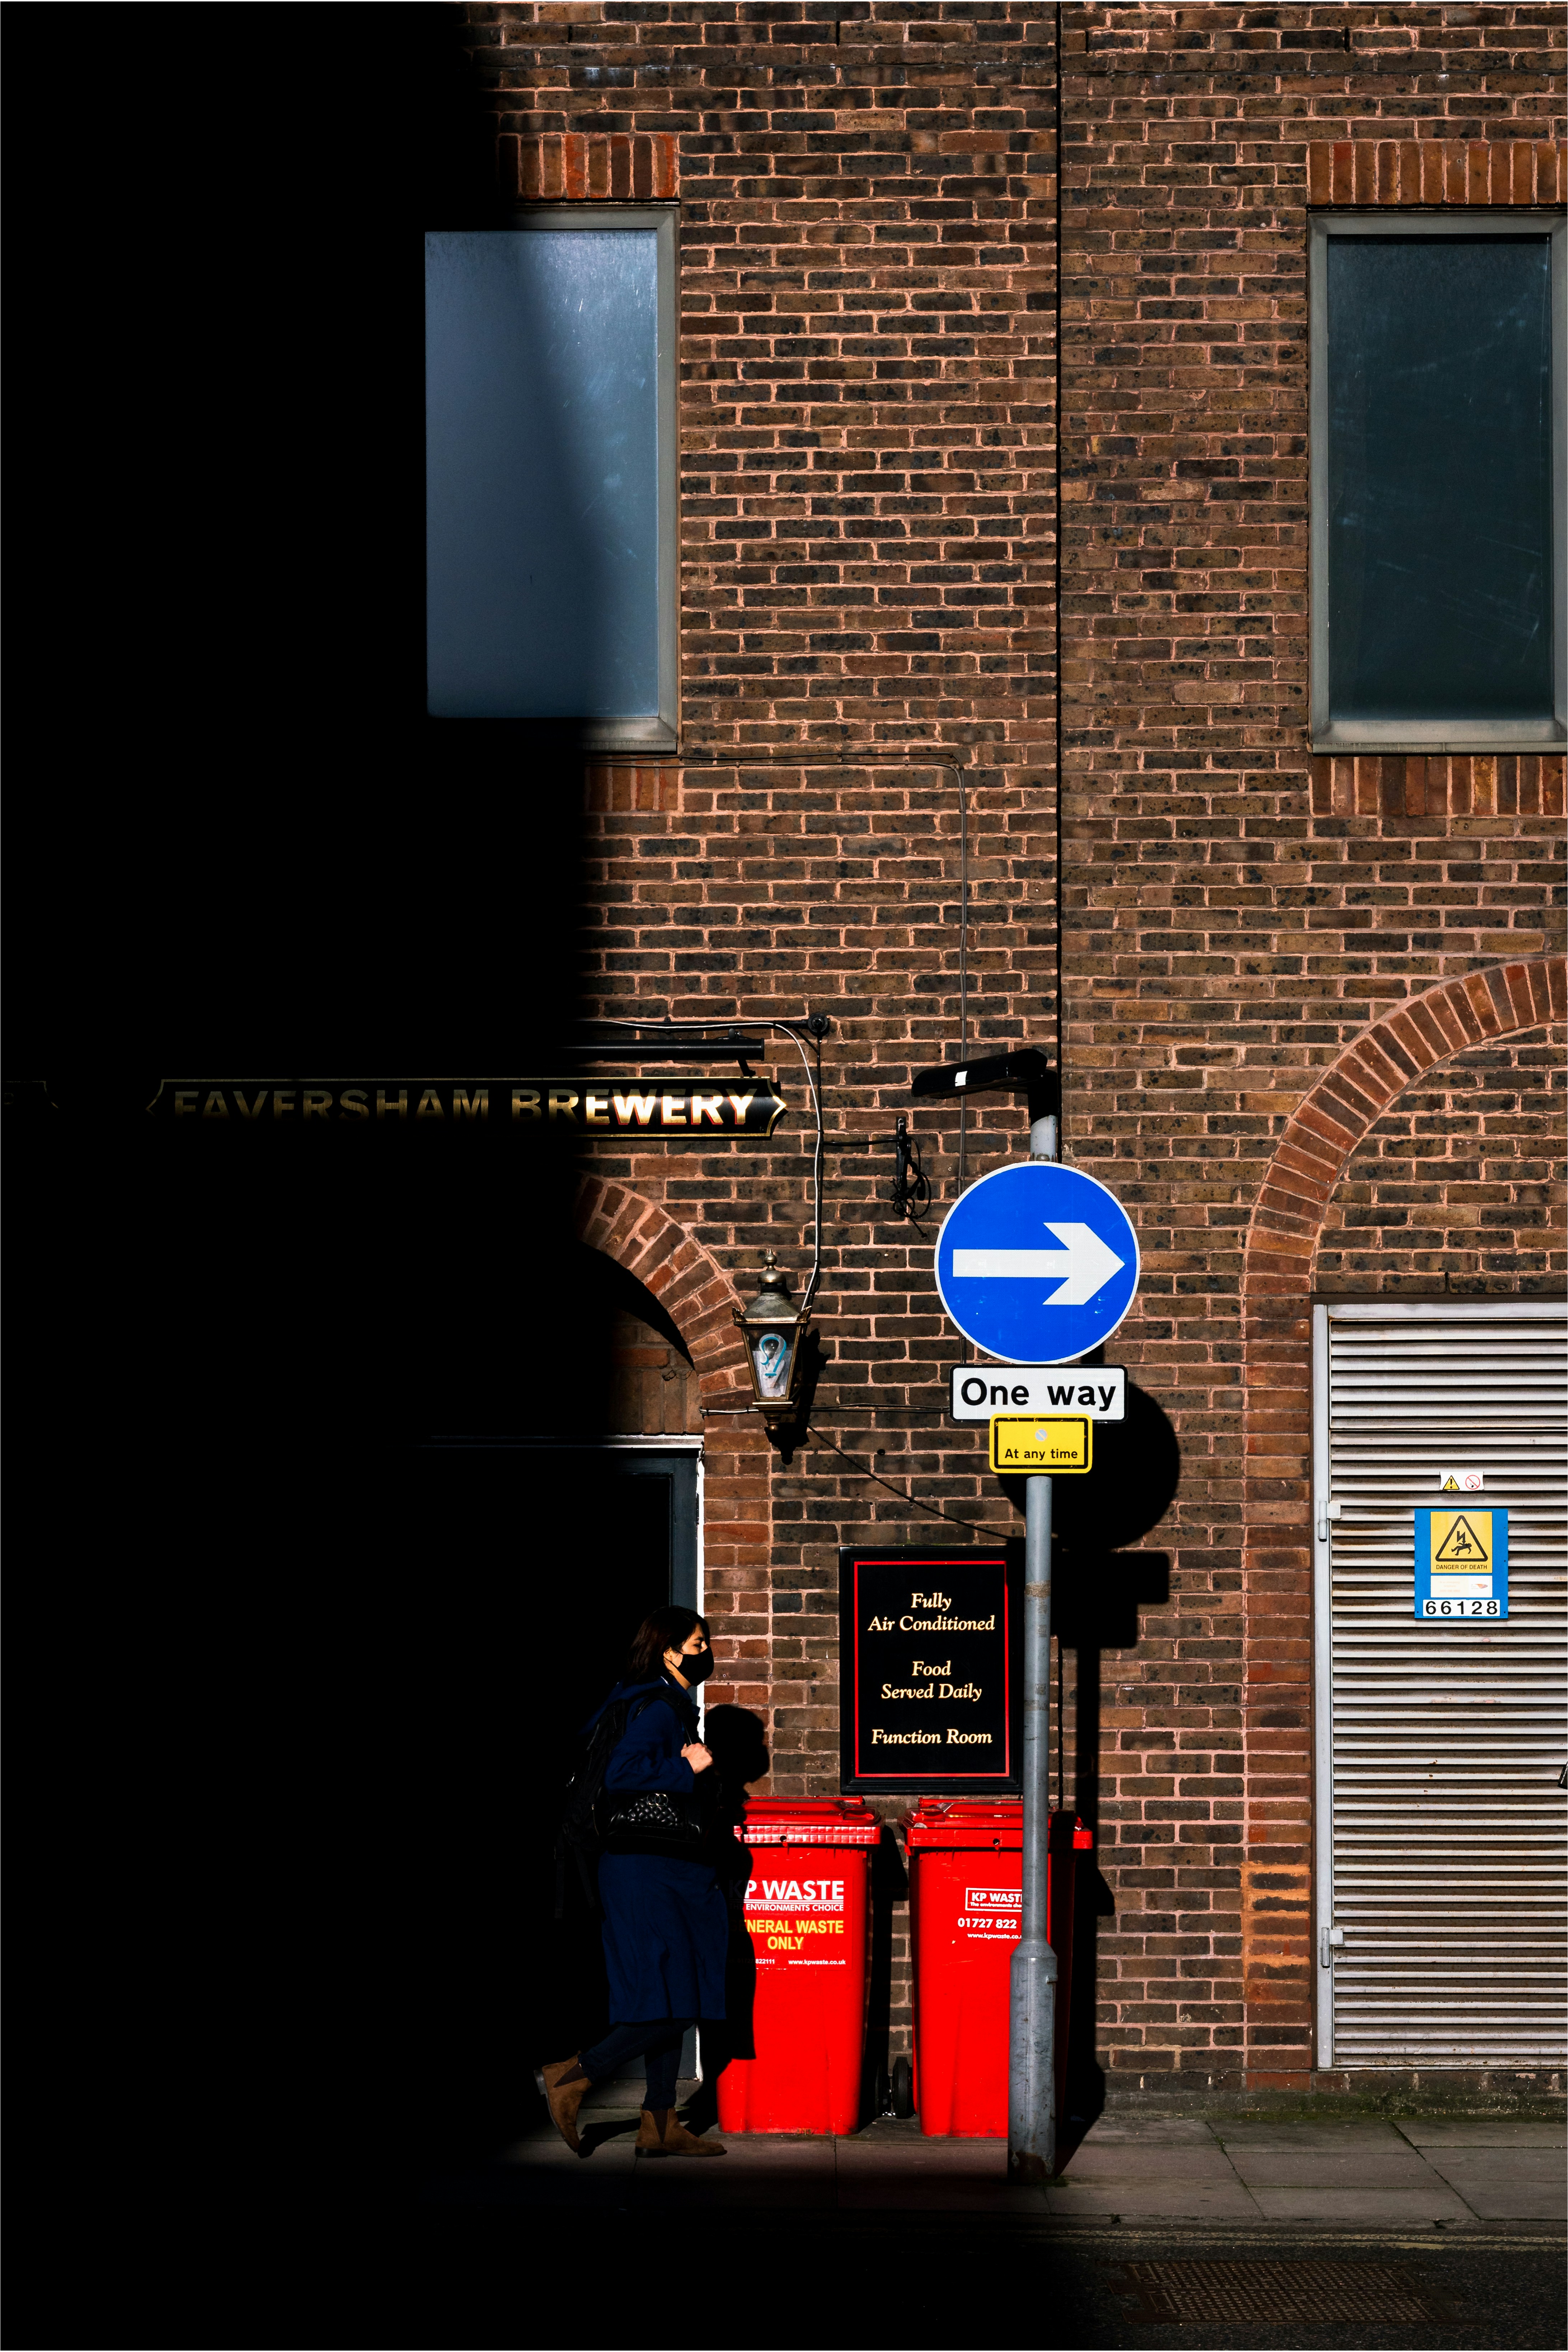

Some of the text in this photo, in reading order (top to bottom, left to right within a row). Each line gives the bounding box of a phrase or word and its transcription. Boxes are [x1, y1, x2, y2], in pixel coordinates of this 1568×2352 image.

[174, 1088, 758, 1125] FAVERSHAM BREWERY
[961, 1378, 1116, 1411] One way
[1005, 1449, 1078, 1460] At any time
[911, 1592, 952, 1611] Fully
[1426, 1601, 1497, 1615] 66128
[868, 1615, 995, 1631] Air Conditioned
[912, 1660, 951, 1676] Food
[881, 1683, 982, 1701] Served Daily
[871, 1729, 992, 1744] Function Room
[762, 1881, 844, 1900] WASTE
[972, 1892, 987, 1901] KP
[729, 1920, 844, 1933] NERAL WASTE
[958, 1918, 1017, 1929] 01727 822
[767, 1936, 804, 1949] ONLY
